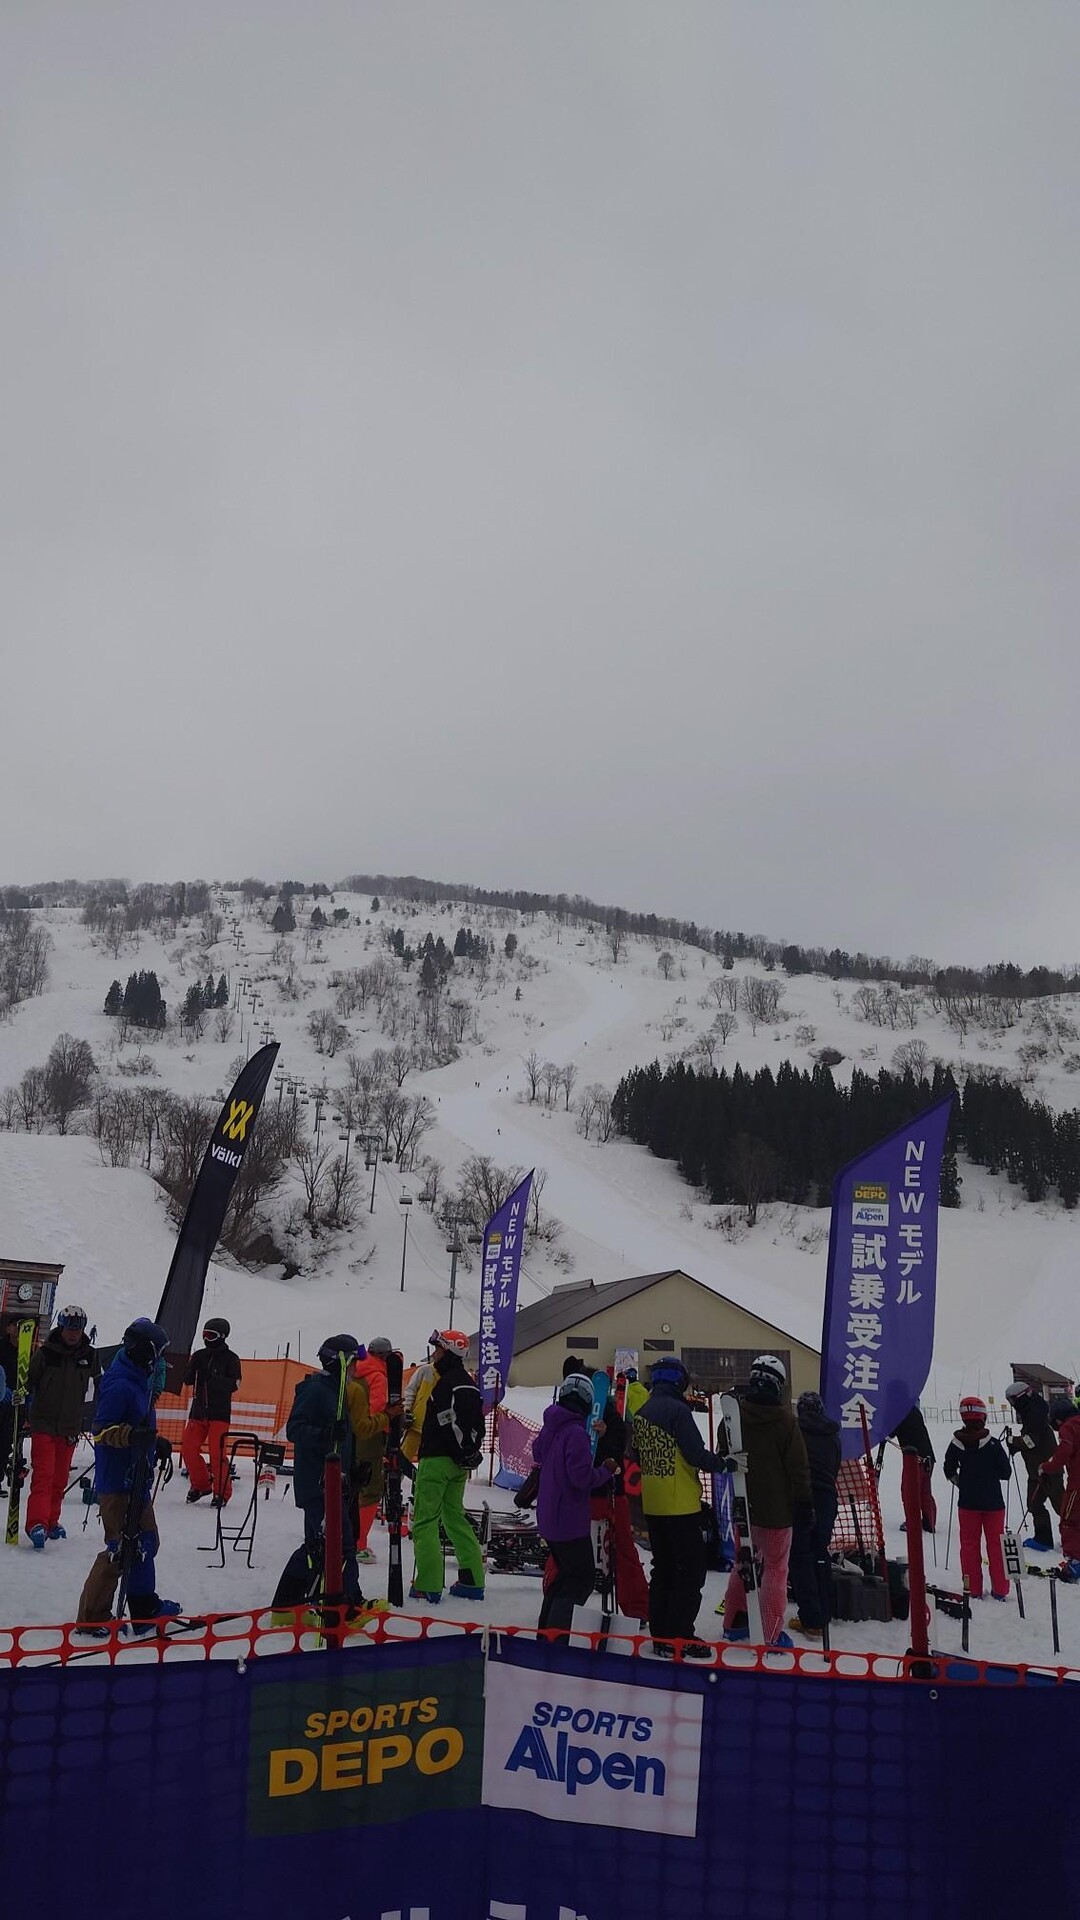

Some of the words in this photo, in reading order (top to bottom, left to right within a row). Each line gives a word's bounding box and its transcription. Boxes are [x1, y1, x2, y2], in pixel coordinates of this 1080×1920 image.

[211, 1143, 242, 1168] Völkl
[855, 1190, 886, 1199] DEPO
[856, 1211, 884, 1222] Alpen
[481, 1264, 502, 1390] 試乗受注会
[840, 1233, 888, 1430] 試乗受注会
[304, 1696, 439, 1738] SPORTS
[532, 1701, 653, 1742] SPORTS
[268, 1727, 464, 1797] DEPO
[504, 1725, 666, 1796] Alpen
